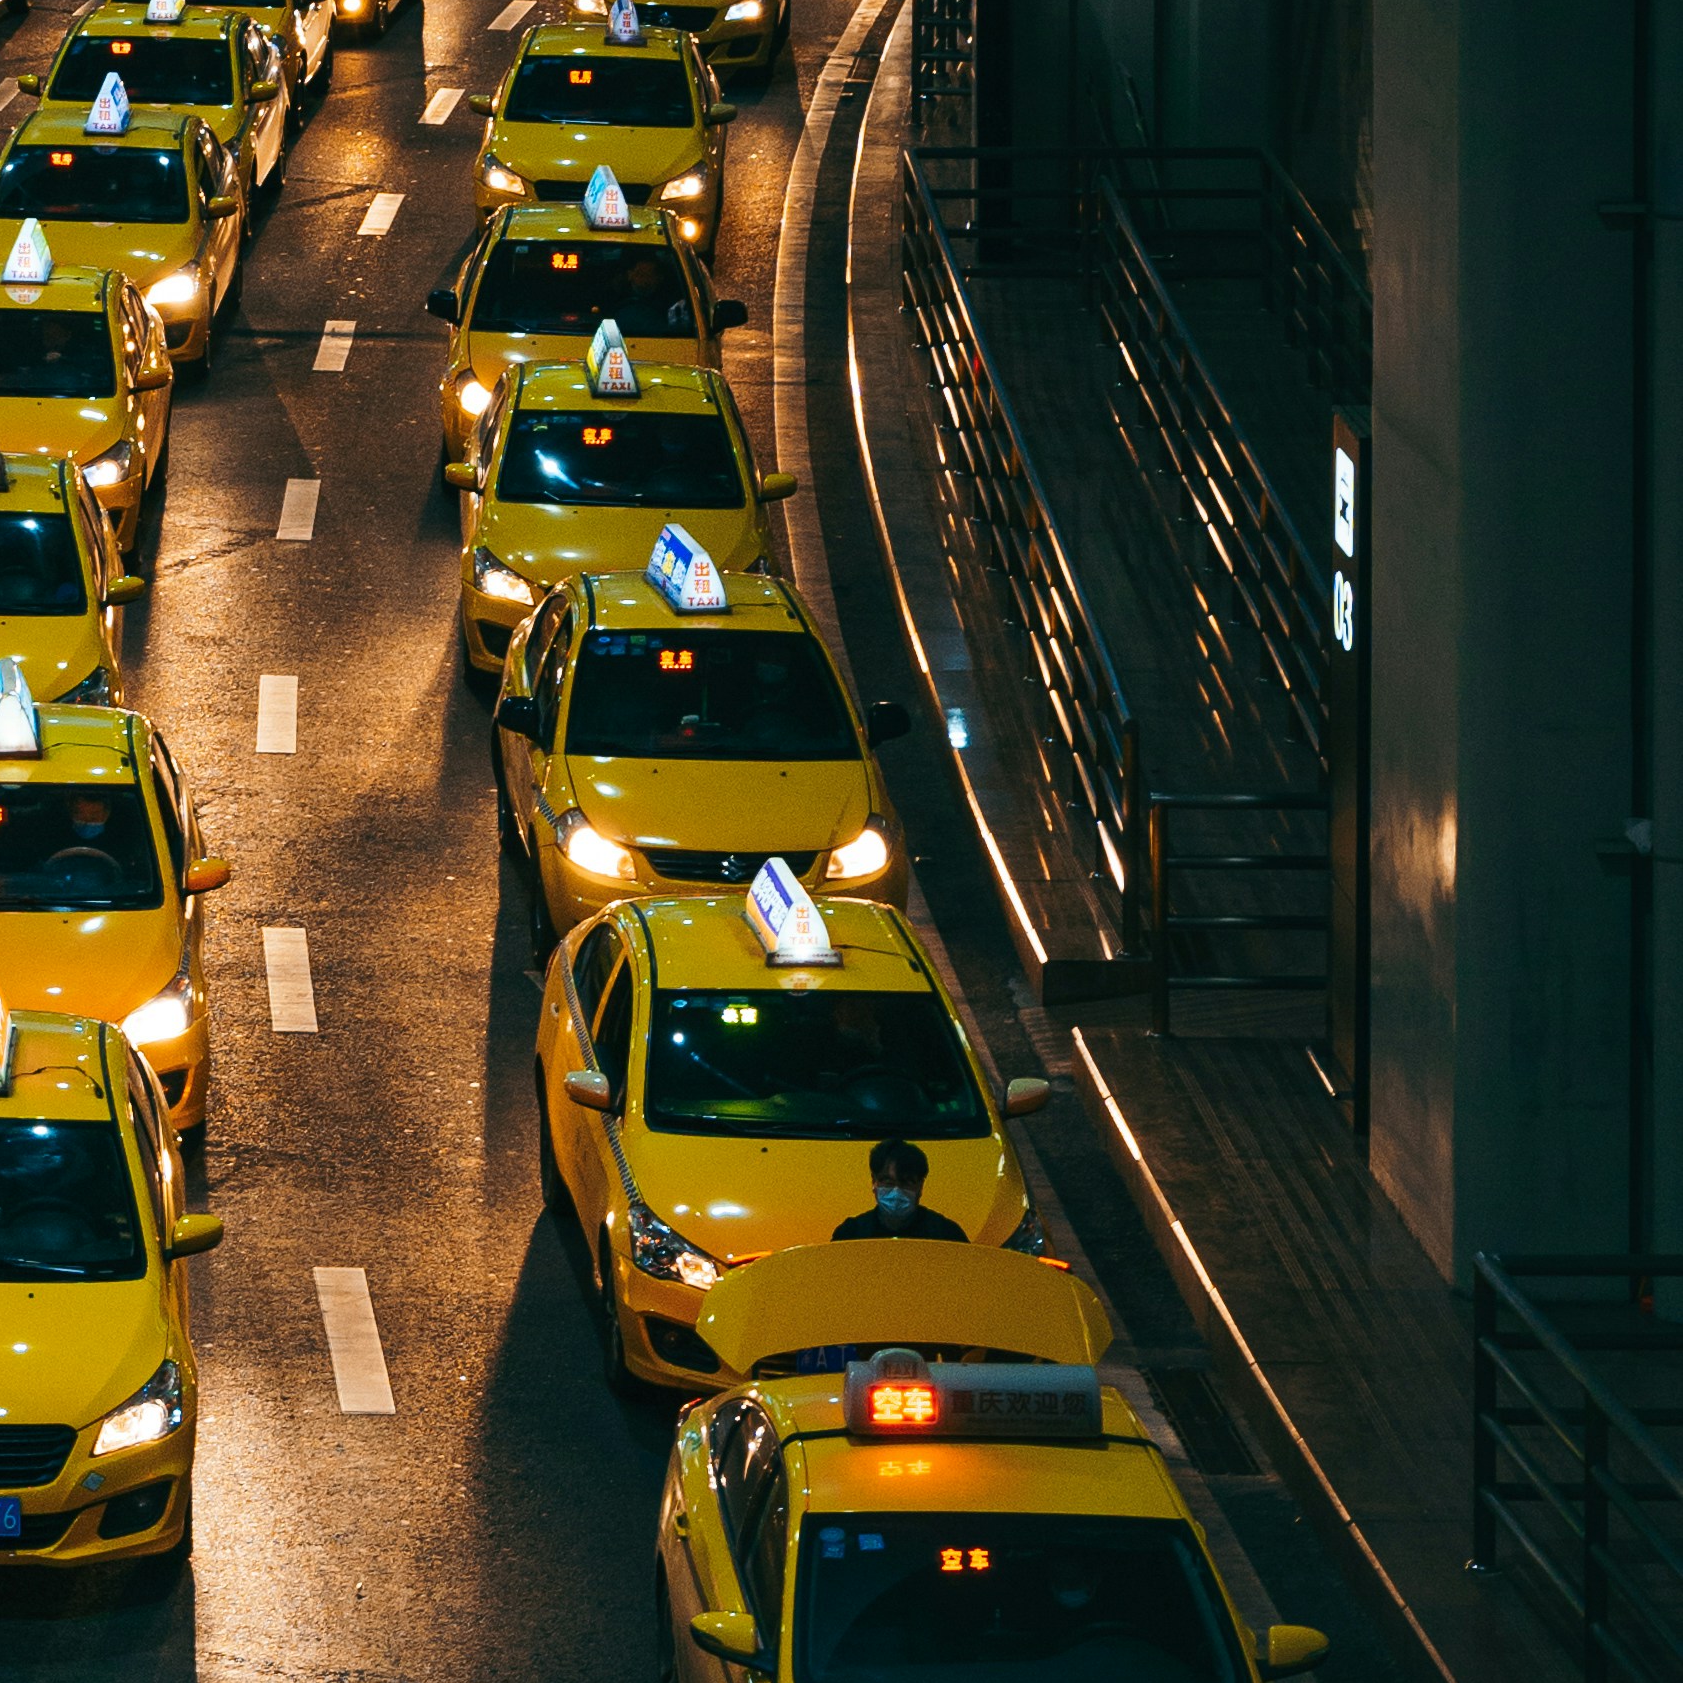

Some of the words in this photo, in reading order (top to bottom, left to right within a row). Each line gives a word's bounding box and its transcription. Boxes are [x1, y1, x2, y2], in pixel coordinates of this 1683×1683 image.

[94, 122, 117, 130] TAXI
[599, 216, 626, 225] TAXI
[12, 270, 38, 279] TAXI
[609, 352, 623, 379] 出租
[603, 381, 631, 391] TAXI
[695, 562, 711, 593] 出租
[688, 597, 720, 606] TAXI
[1333, 570, 1354, 652] 03
[791, 936, 817, 945] TAXI
[872, 1387, 933, 1421] 空车
[951, 1390, 1087, 1416] 重庆欢迎您
[940, 1548, 990, 1571] 空车
